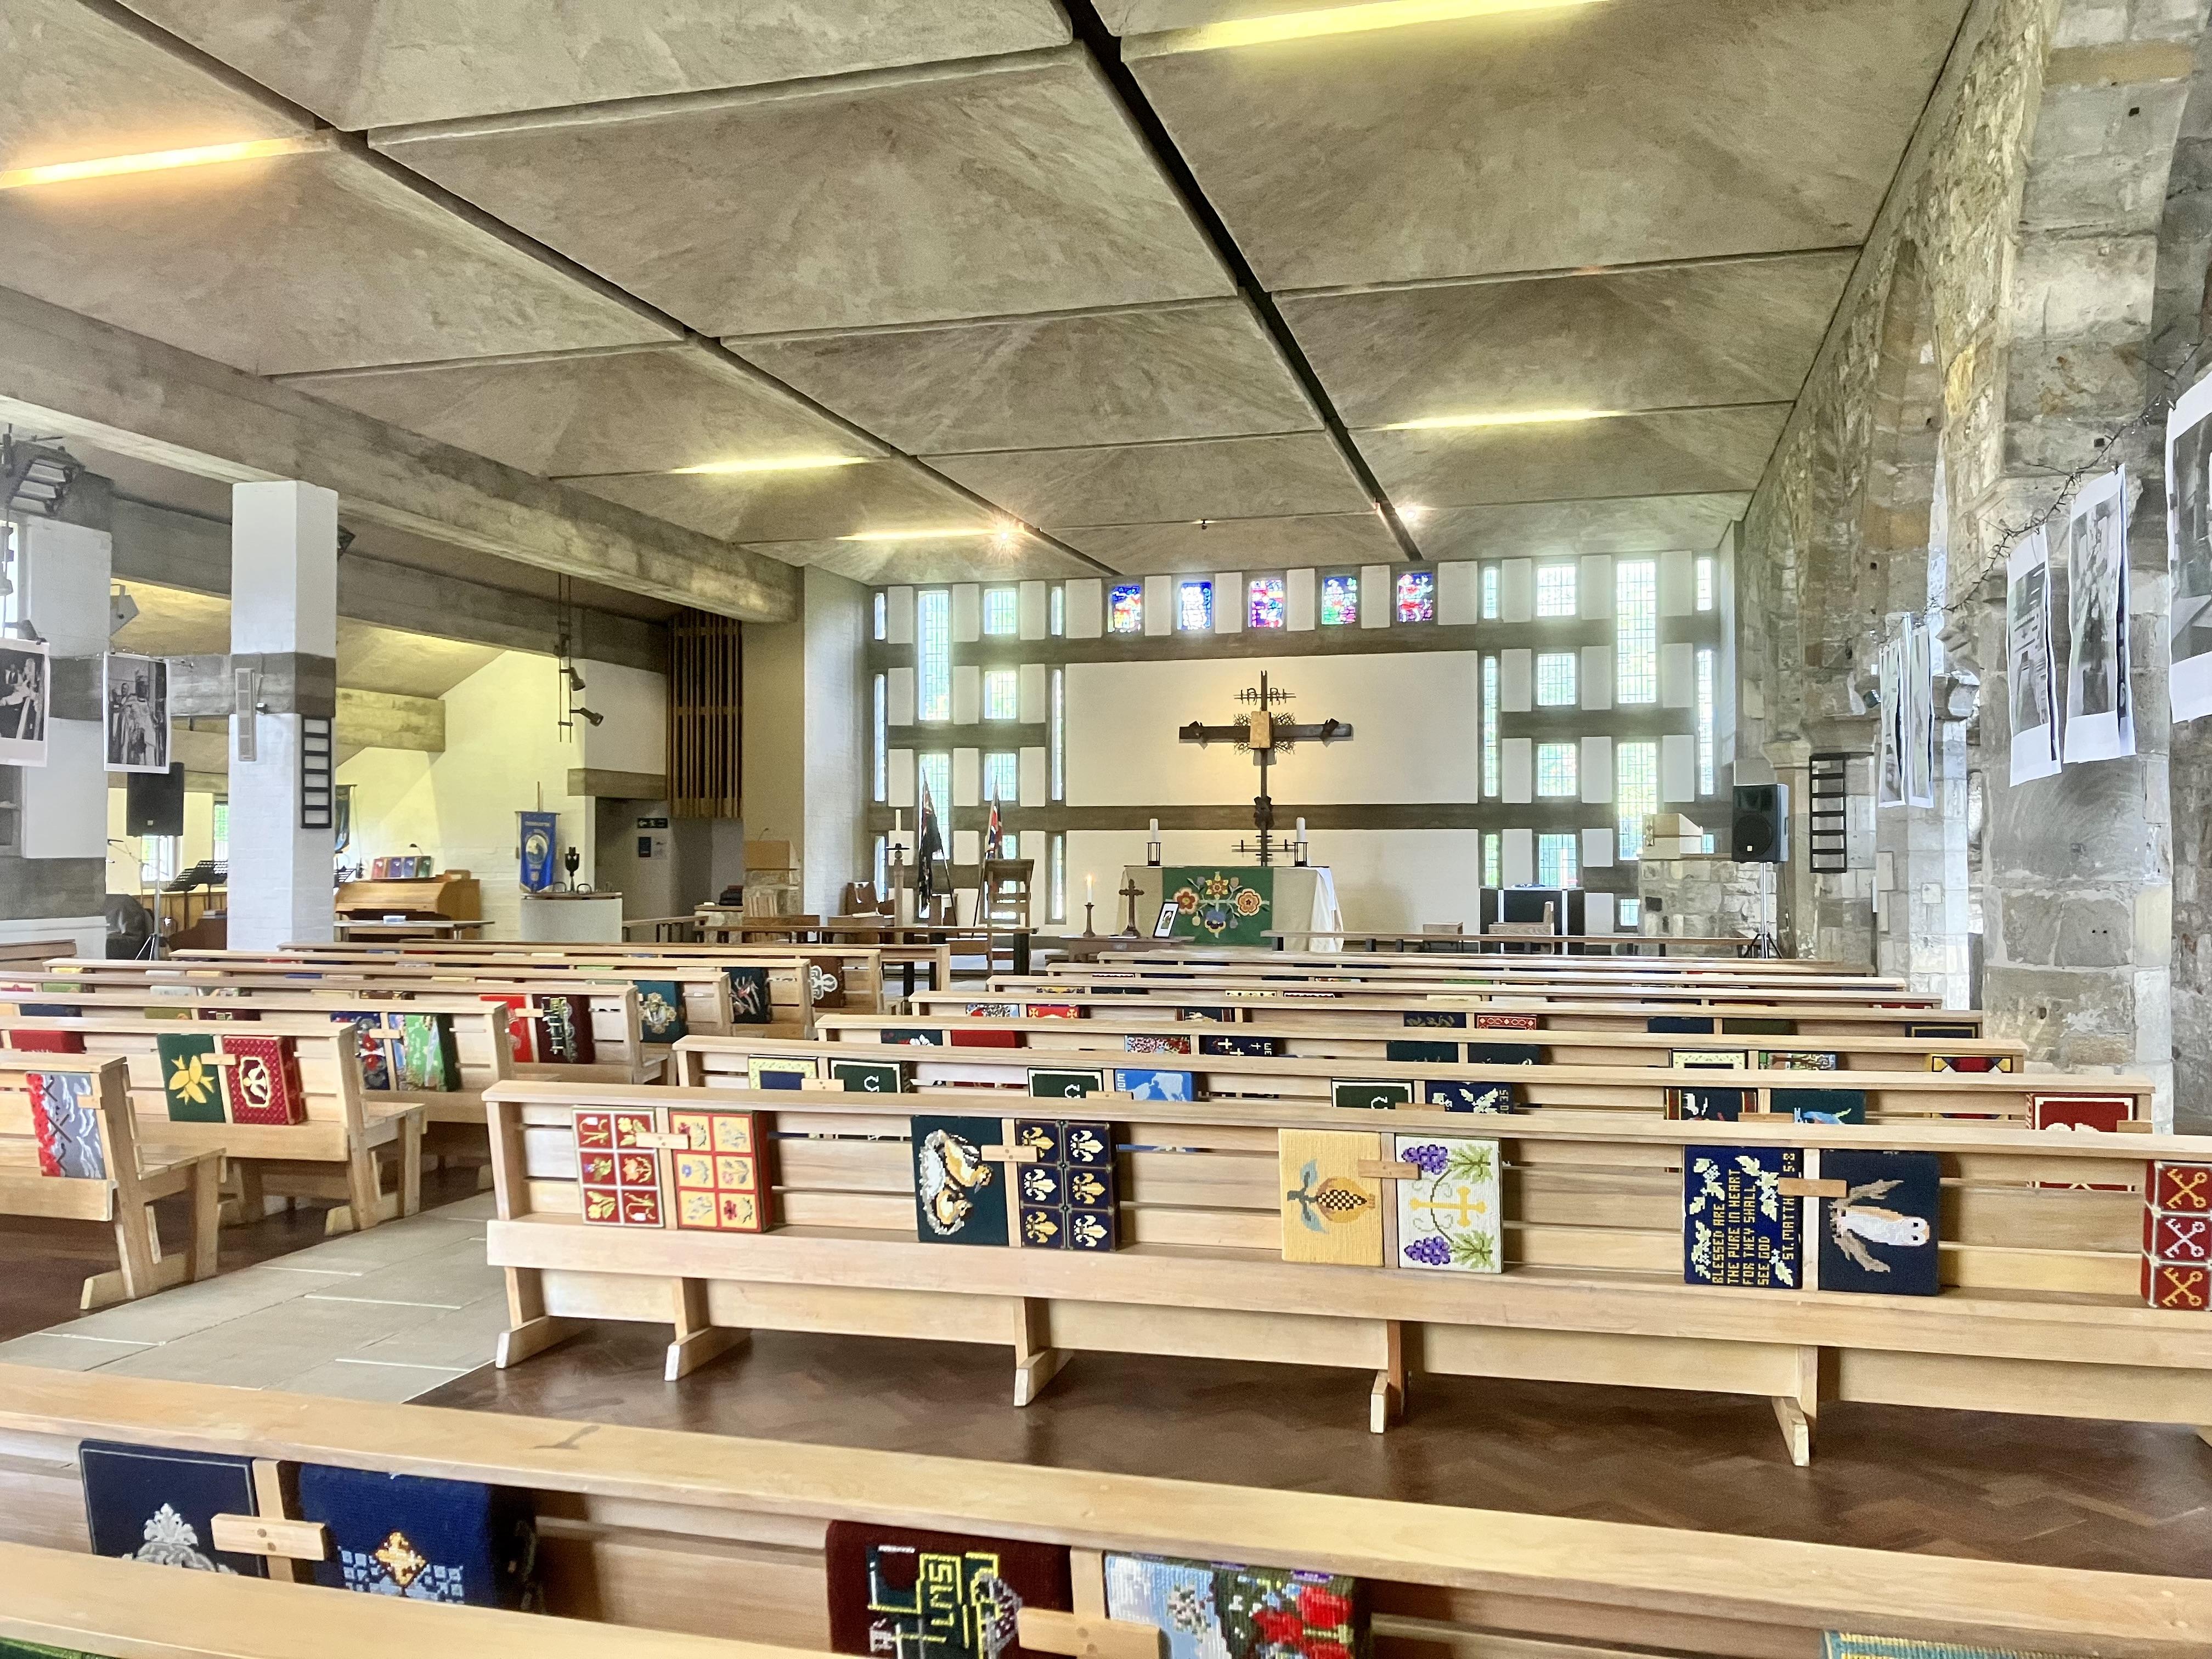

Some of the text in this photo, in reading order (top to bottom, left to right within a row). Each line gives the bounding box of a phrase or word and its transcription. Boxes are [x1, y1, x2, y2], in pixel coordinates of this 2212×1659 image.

[1712, 1204, 1725, 1284] BLESSED ARE
[1728, 1169, 1741, 1284] THE PURE IN HEART
[1742, 1185, 1756, 1285] FOR THEY SHALL
[1757, 1236, 1770, 1285] SEE GOD
